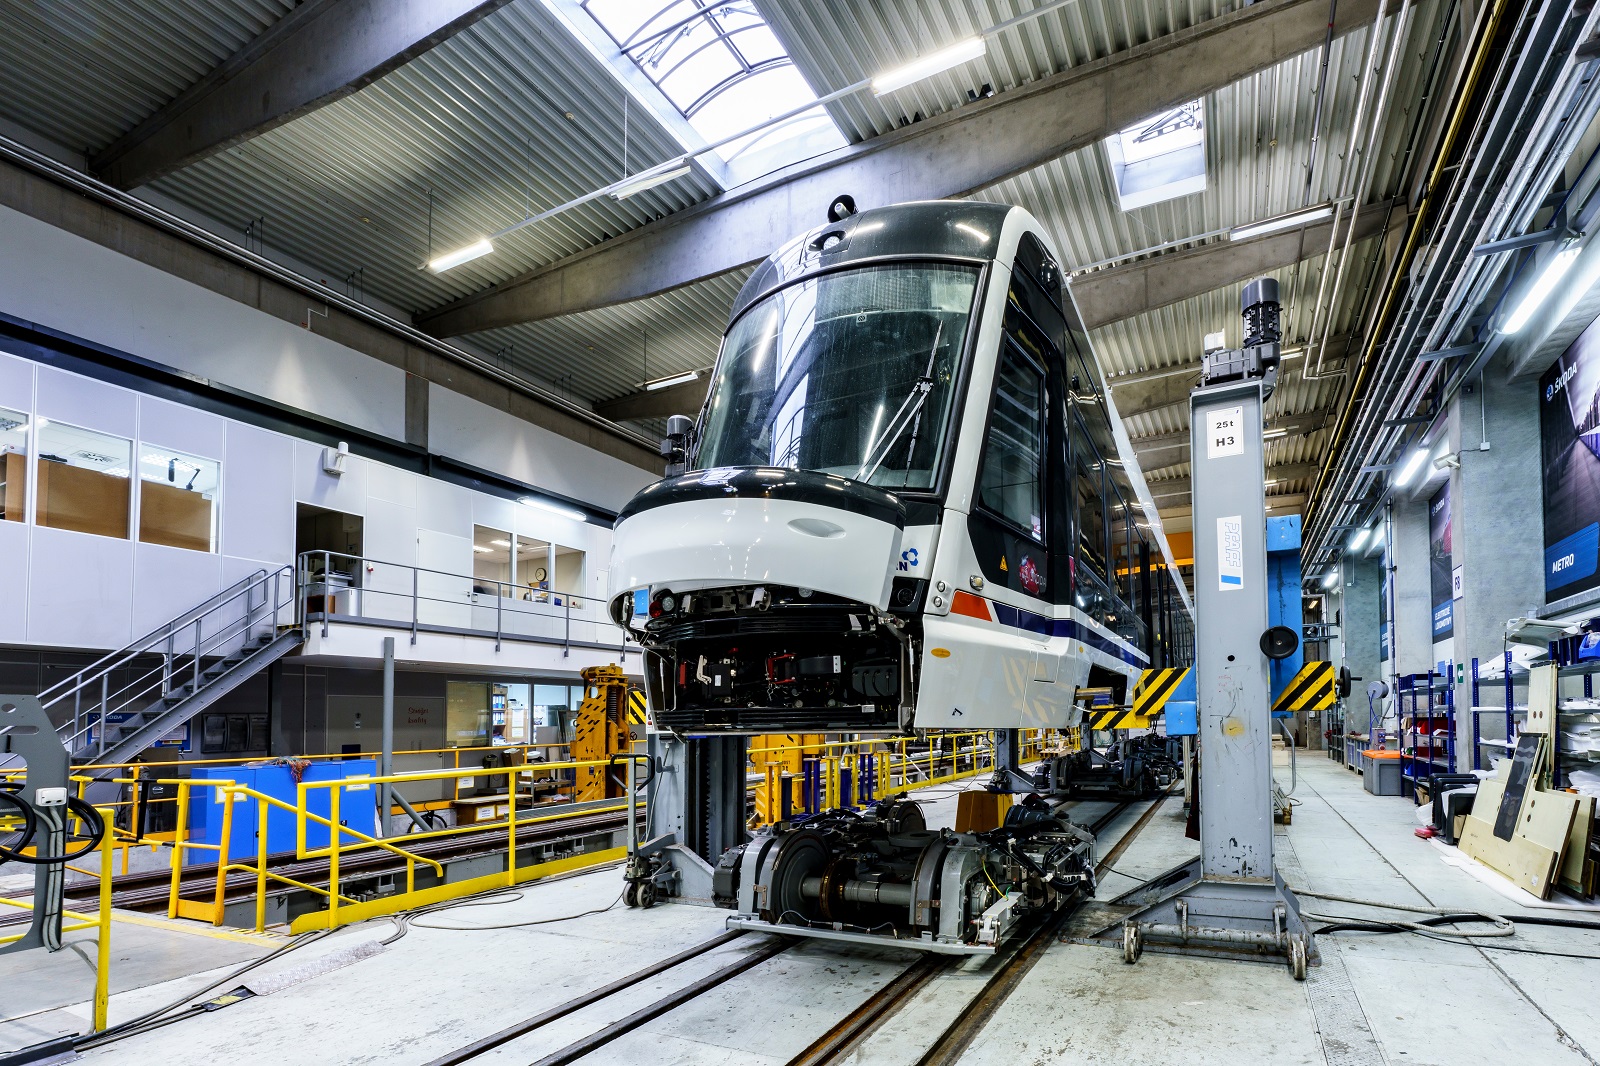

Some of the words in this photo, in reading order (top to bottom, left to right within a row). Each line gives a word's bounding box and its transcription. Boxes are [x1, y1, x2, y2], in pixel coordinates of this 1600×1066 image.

[1554, 361, 1577, 394] ŠKODA
[1216, 436, 1235, 447] H3
[1552, 553, 1575, 574] METRO
